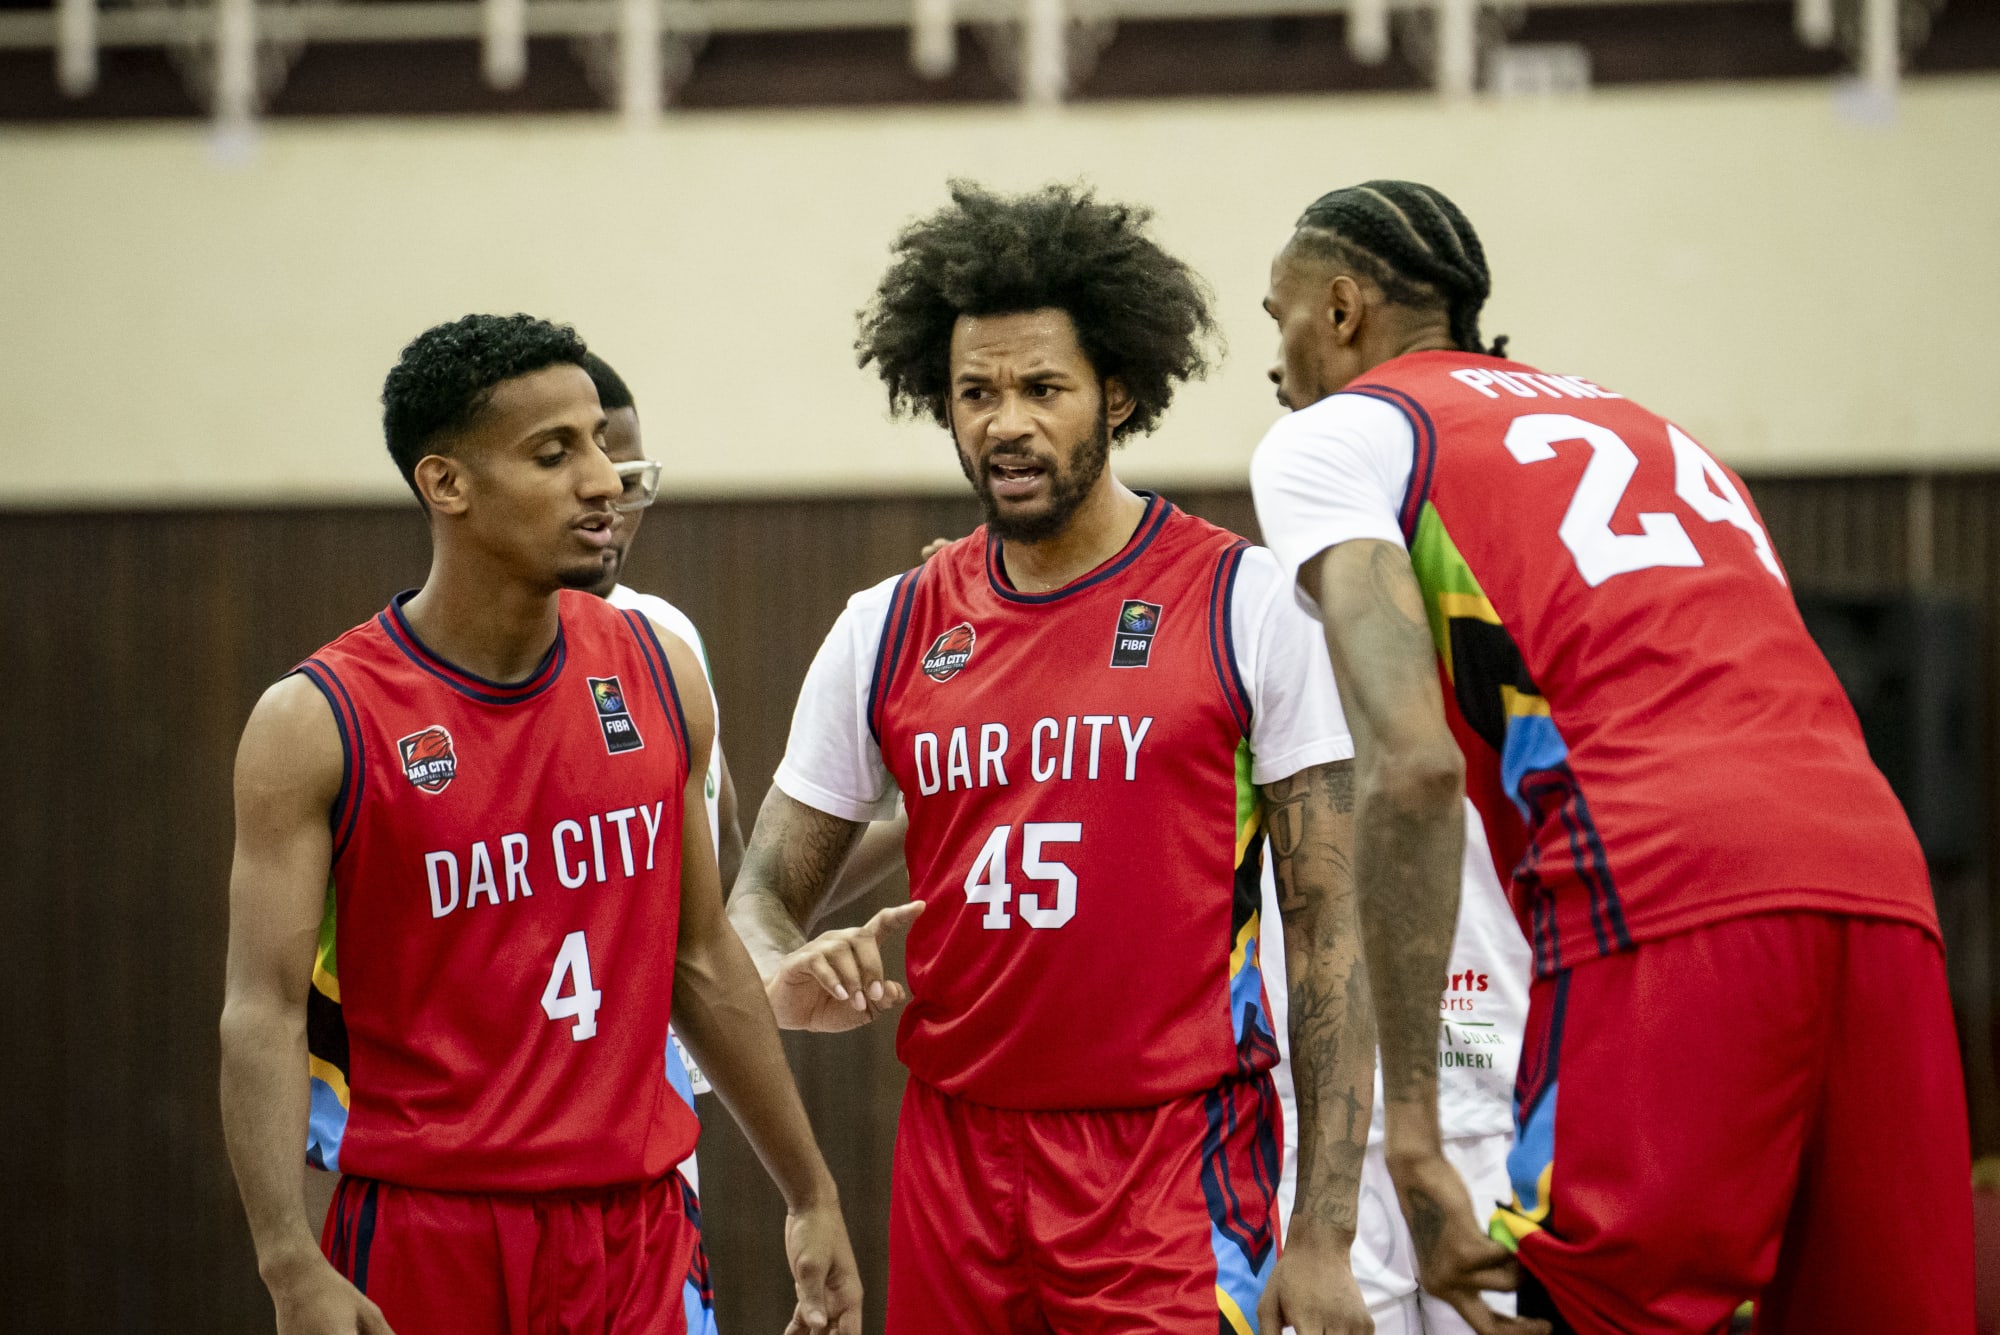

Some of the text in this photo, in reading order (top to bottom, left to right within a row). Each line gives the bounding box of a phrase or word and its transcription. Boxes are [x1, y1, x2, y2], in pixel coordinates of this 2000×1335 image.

[1503, 413, 1788, 589] 24
[924, 656, 946, 669] DAR
[946, 653, 969, 665] CITY
[1120, 639, 1147, 651] FIBA
[429, 760, 453, 773] CITY
[605, 718, 631, 734] FIBA
[914, 714, 1155, 798] DAR CITY
[424, 800, 664, 919] DAR CITY
[963, 821, 1083, 930] 45
[540, 929, 602, 1042] 4
